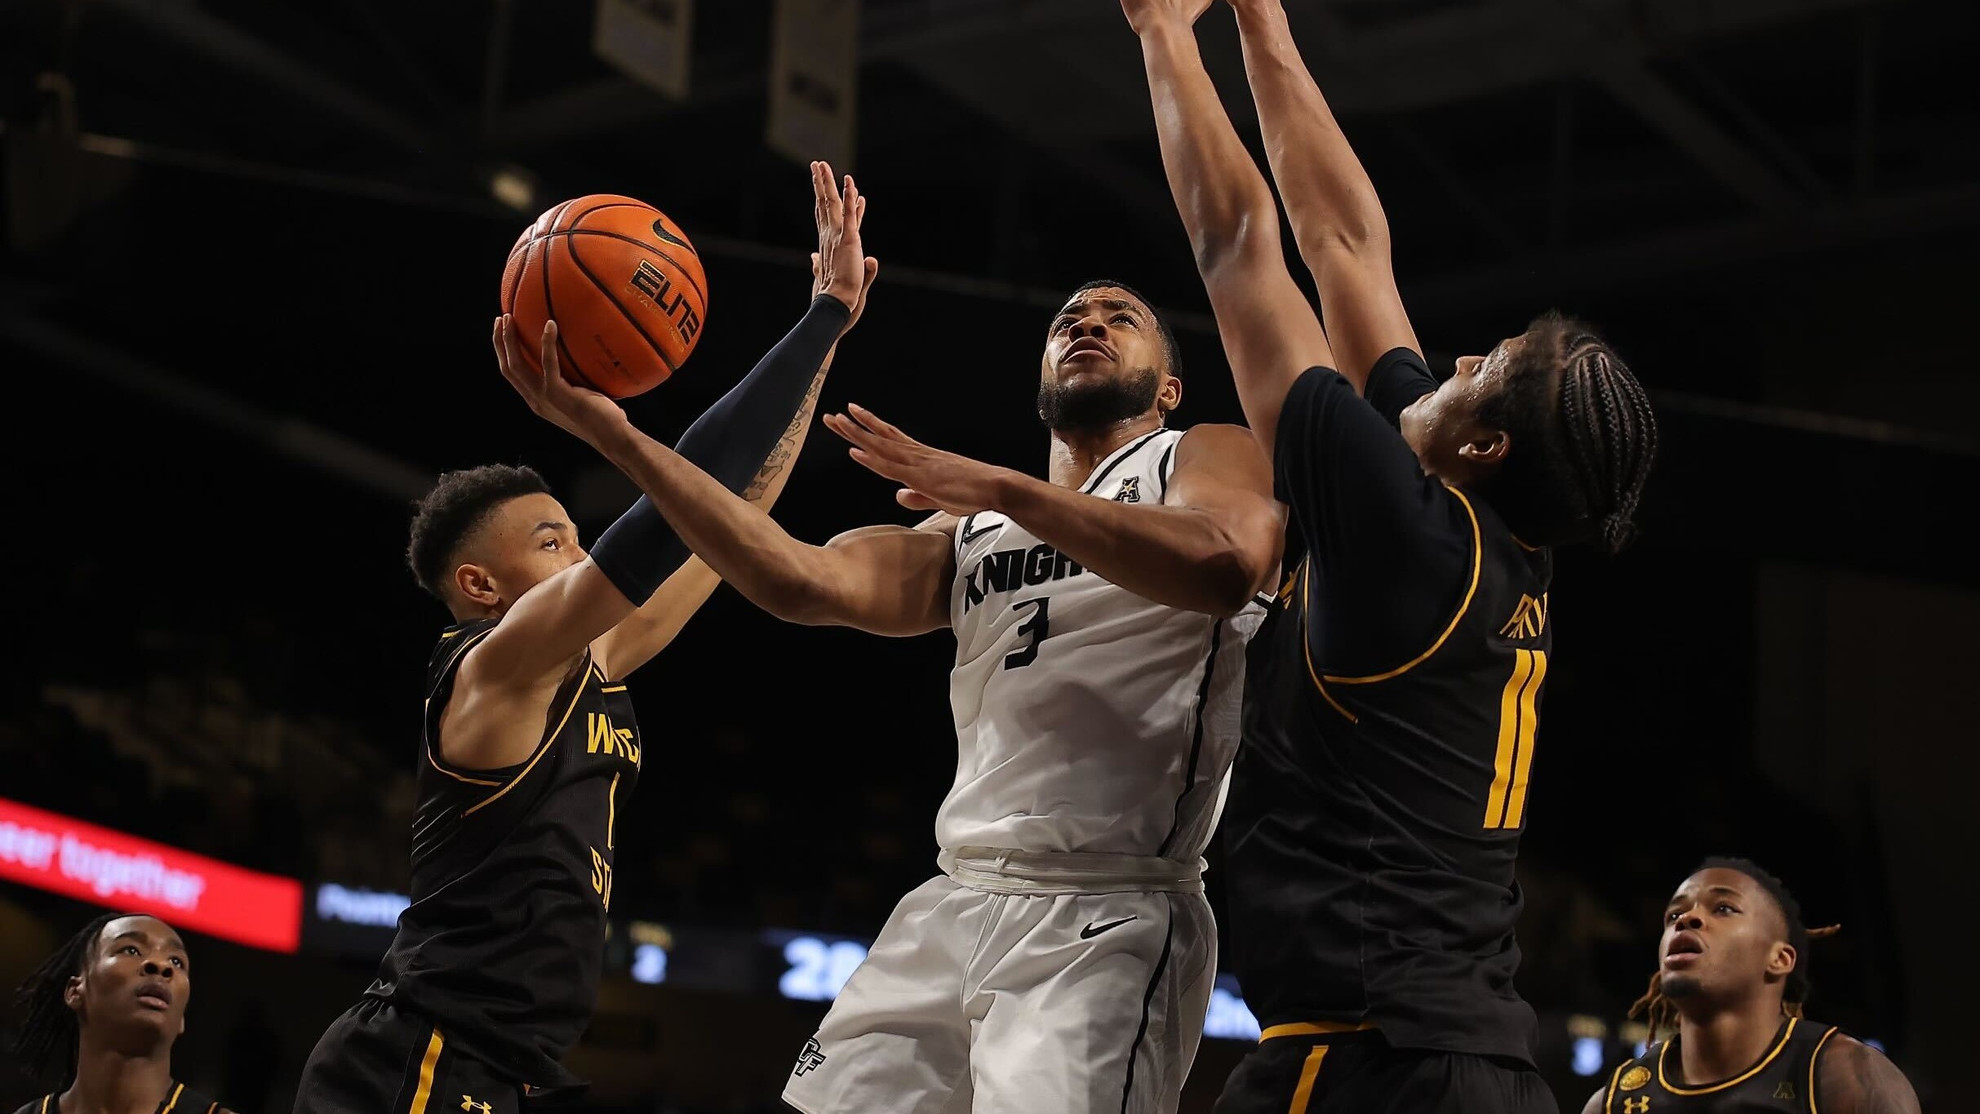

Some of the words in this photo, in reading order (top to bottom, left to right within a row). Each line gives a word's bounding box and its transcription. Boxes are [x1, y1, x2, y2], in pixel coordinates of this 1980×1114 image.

[631, 259, 700, 346] ELITE
[964, 543, 1092, 615] KNIGH
[1004, 598, 1050, 670] 3
[1482, 648, 1548, 829] 11
[59, 830, 206, 914] together
